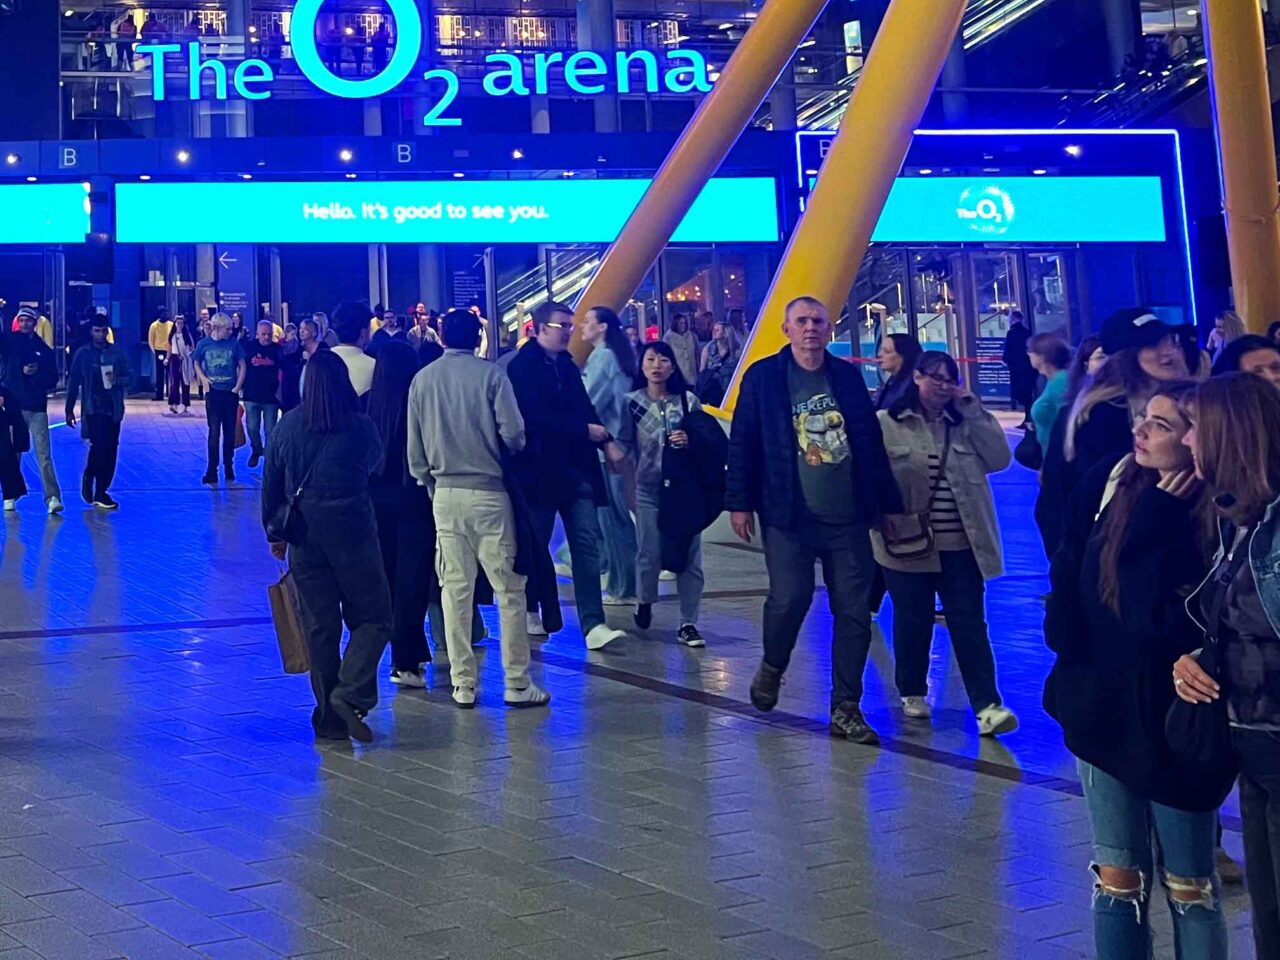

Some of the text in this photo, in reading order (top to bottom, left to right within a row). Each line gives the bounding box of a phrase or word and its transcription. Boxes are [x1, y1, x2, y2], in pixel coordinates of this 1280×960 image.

[135, 41, 274, 102] The
[482, 48, 717, 95] arena
[63, 148, 77, 166] B
[397, 144, 412, 164] B
[303, 202, 357, 220] Hello.
[392, 202, 442, 224] good
[446, 203, 467, 219] to
[471, 205, 505, 219] see
[508, 205, 549, 224] you.
